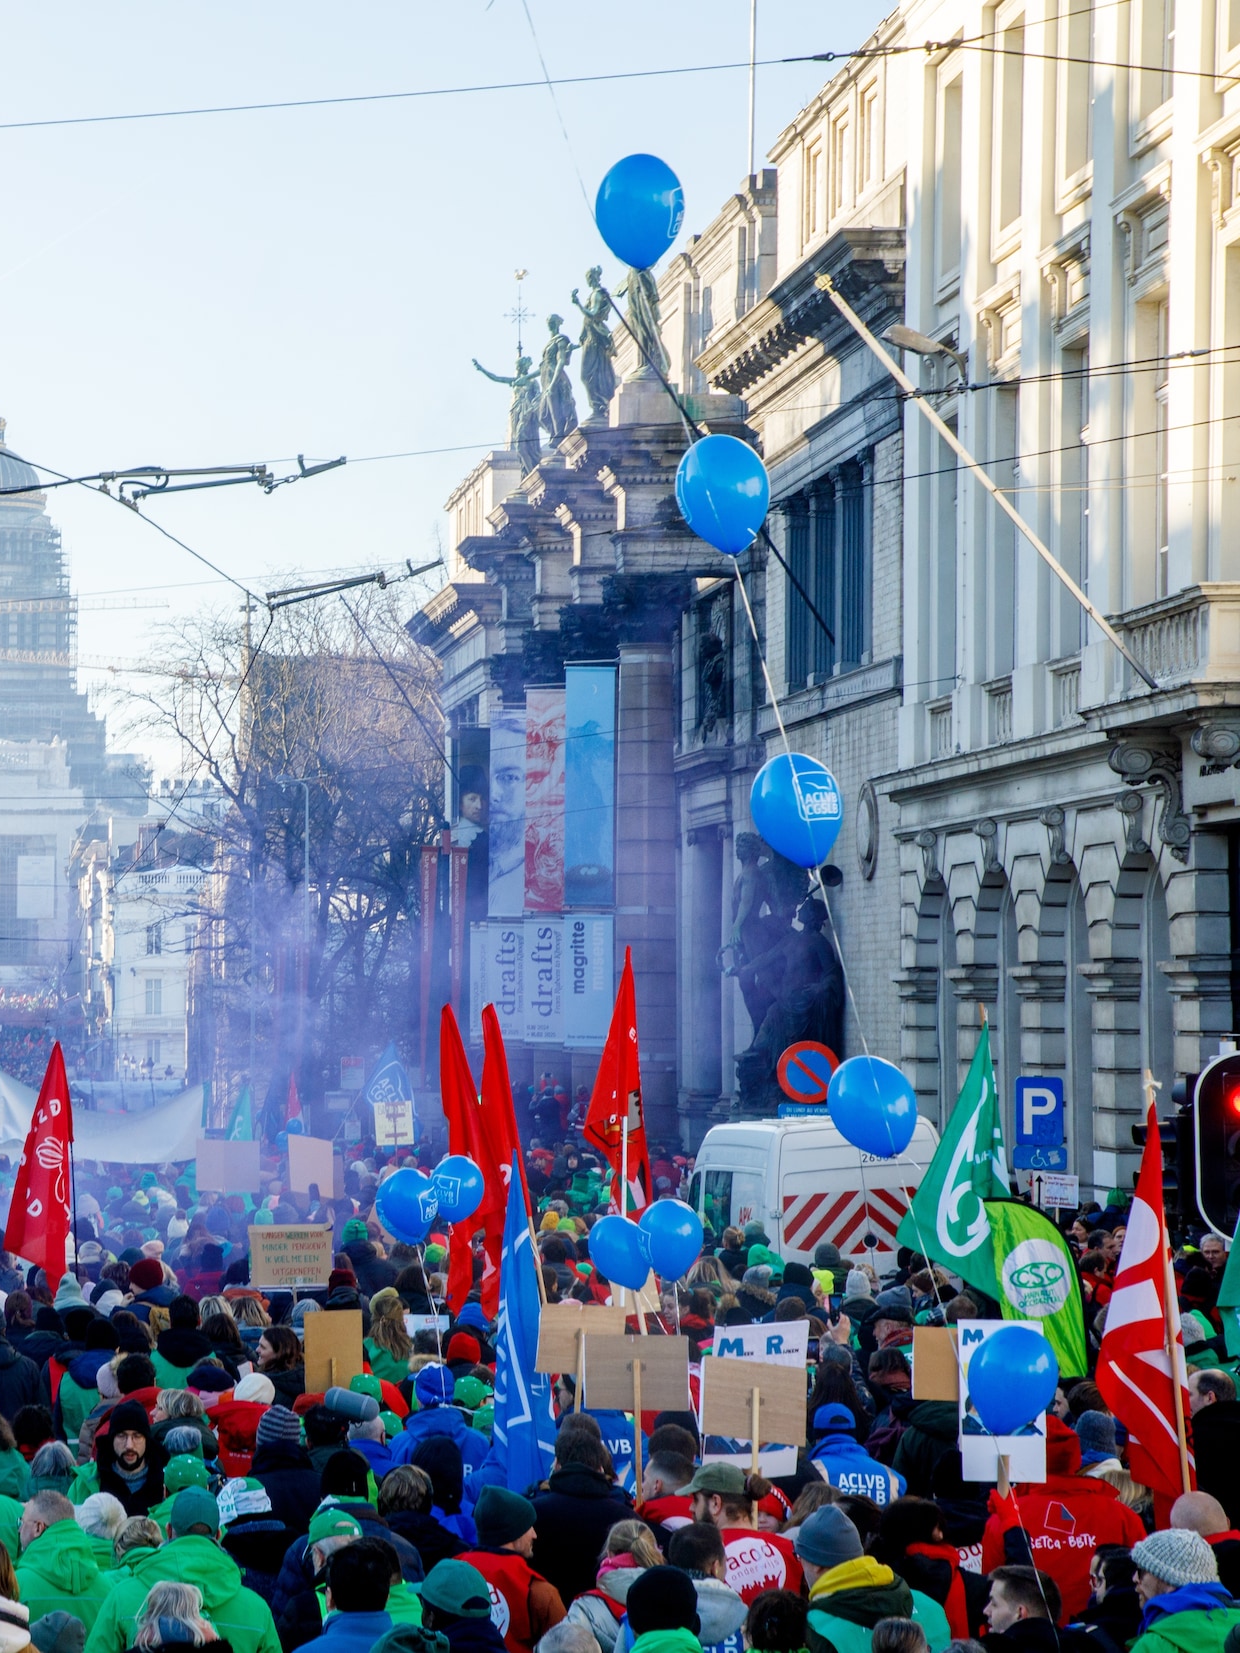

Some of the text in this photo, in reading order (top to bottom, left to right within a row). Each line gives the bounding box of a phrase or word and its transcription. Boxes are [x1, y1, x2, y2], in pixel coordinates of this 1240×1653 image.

[805, 791, 837, 804] ACLVB
[807, 803, 839, 815] CGSLB
[495, 931, 516, 1016] drafts
[531, 927, 553, 1017] drafts
[570, 921, 588, 995] magritte
[592, 920, 604, 991] museum
[1022, 1087, 1057, 1136] P
[1014, 1263, 1061, 1288] CSC
[839, 1473, 886, 1490] ACLVB
